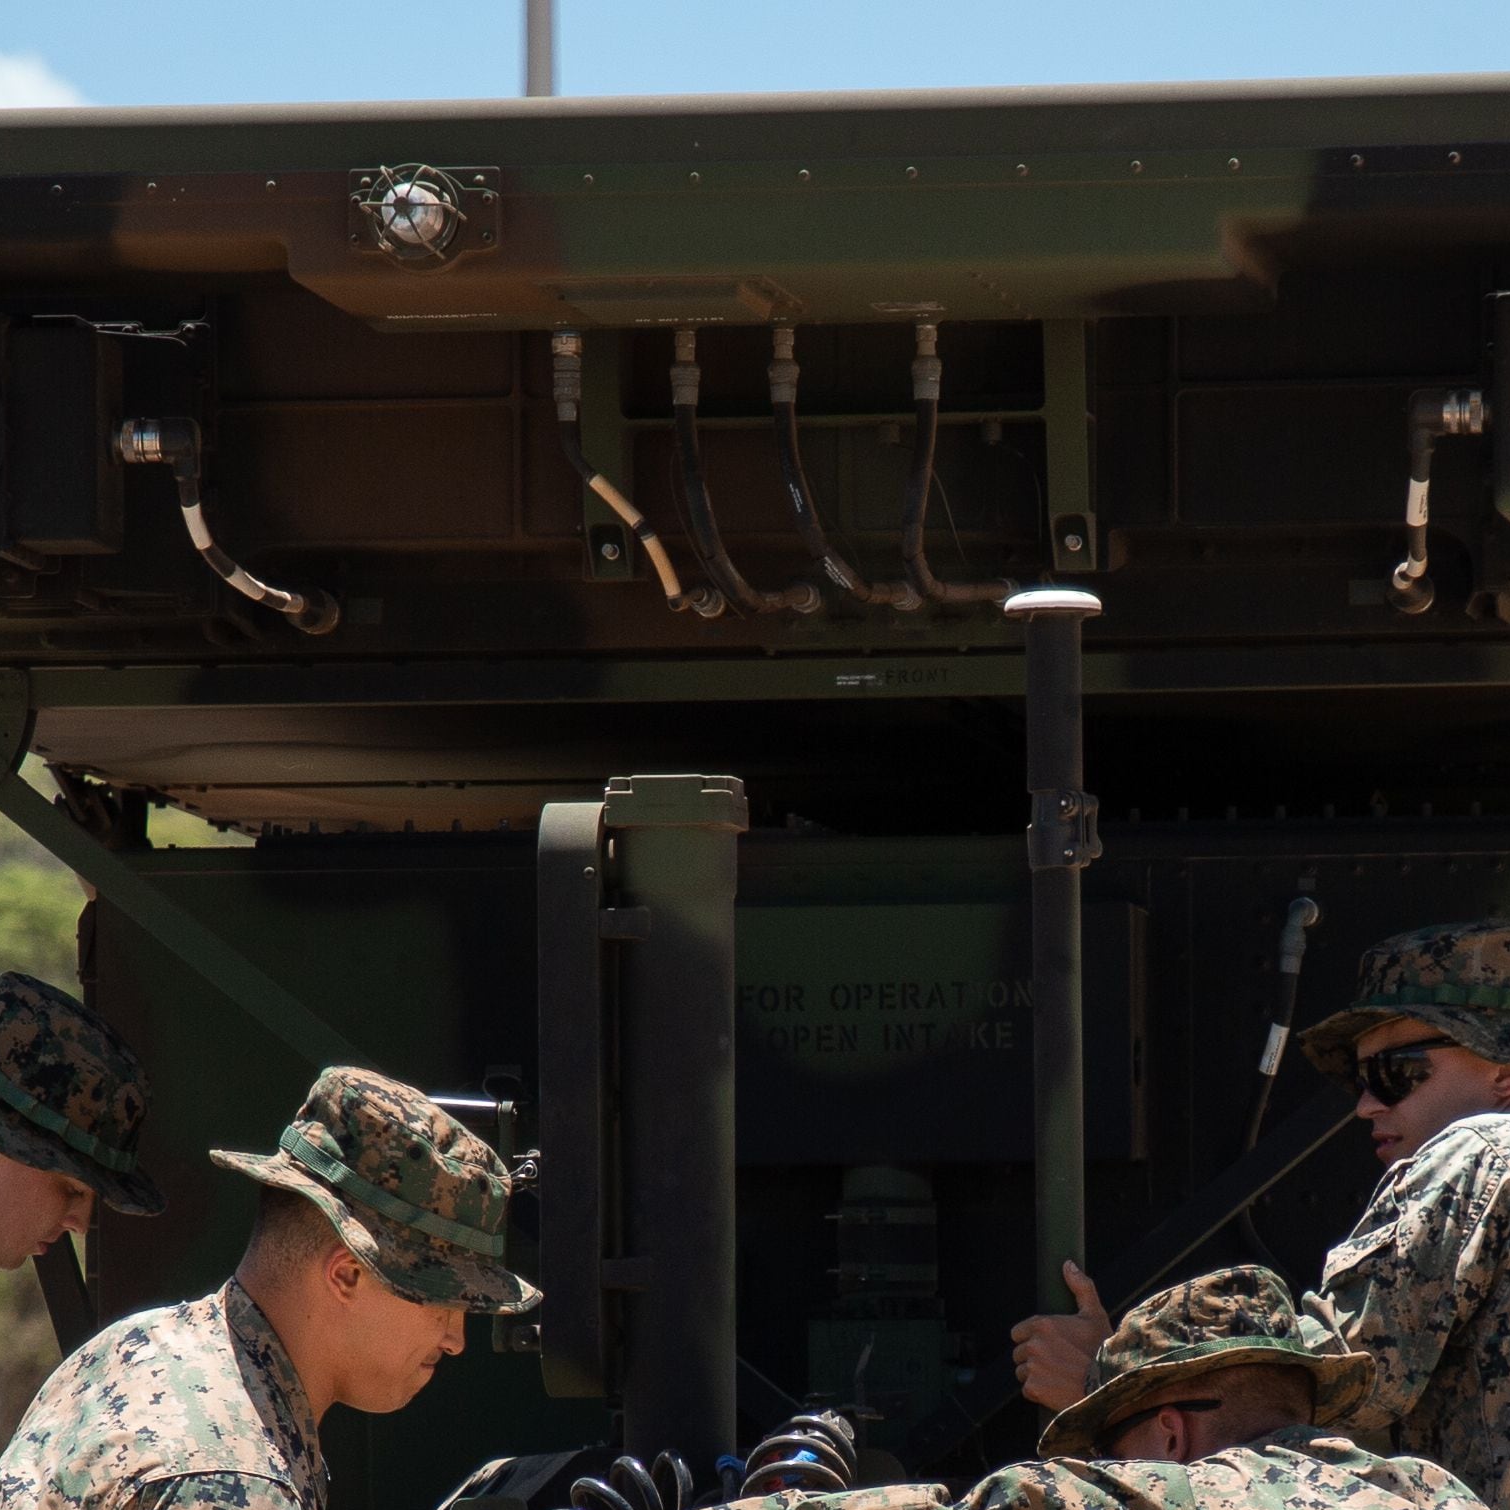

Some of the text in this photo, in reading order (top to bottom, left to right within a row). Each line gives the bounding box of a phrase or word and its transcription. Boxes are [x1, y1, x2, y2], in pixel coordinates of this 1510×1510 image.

[885, 668, 949, 685] FRONT
[736, 982, 806, 1012] FOR
[766, 1020, 1016, 1053] OPEN INTAKE
